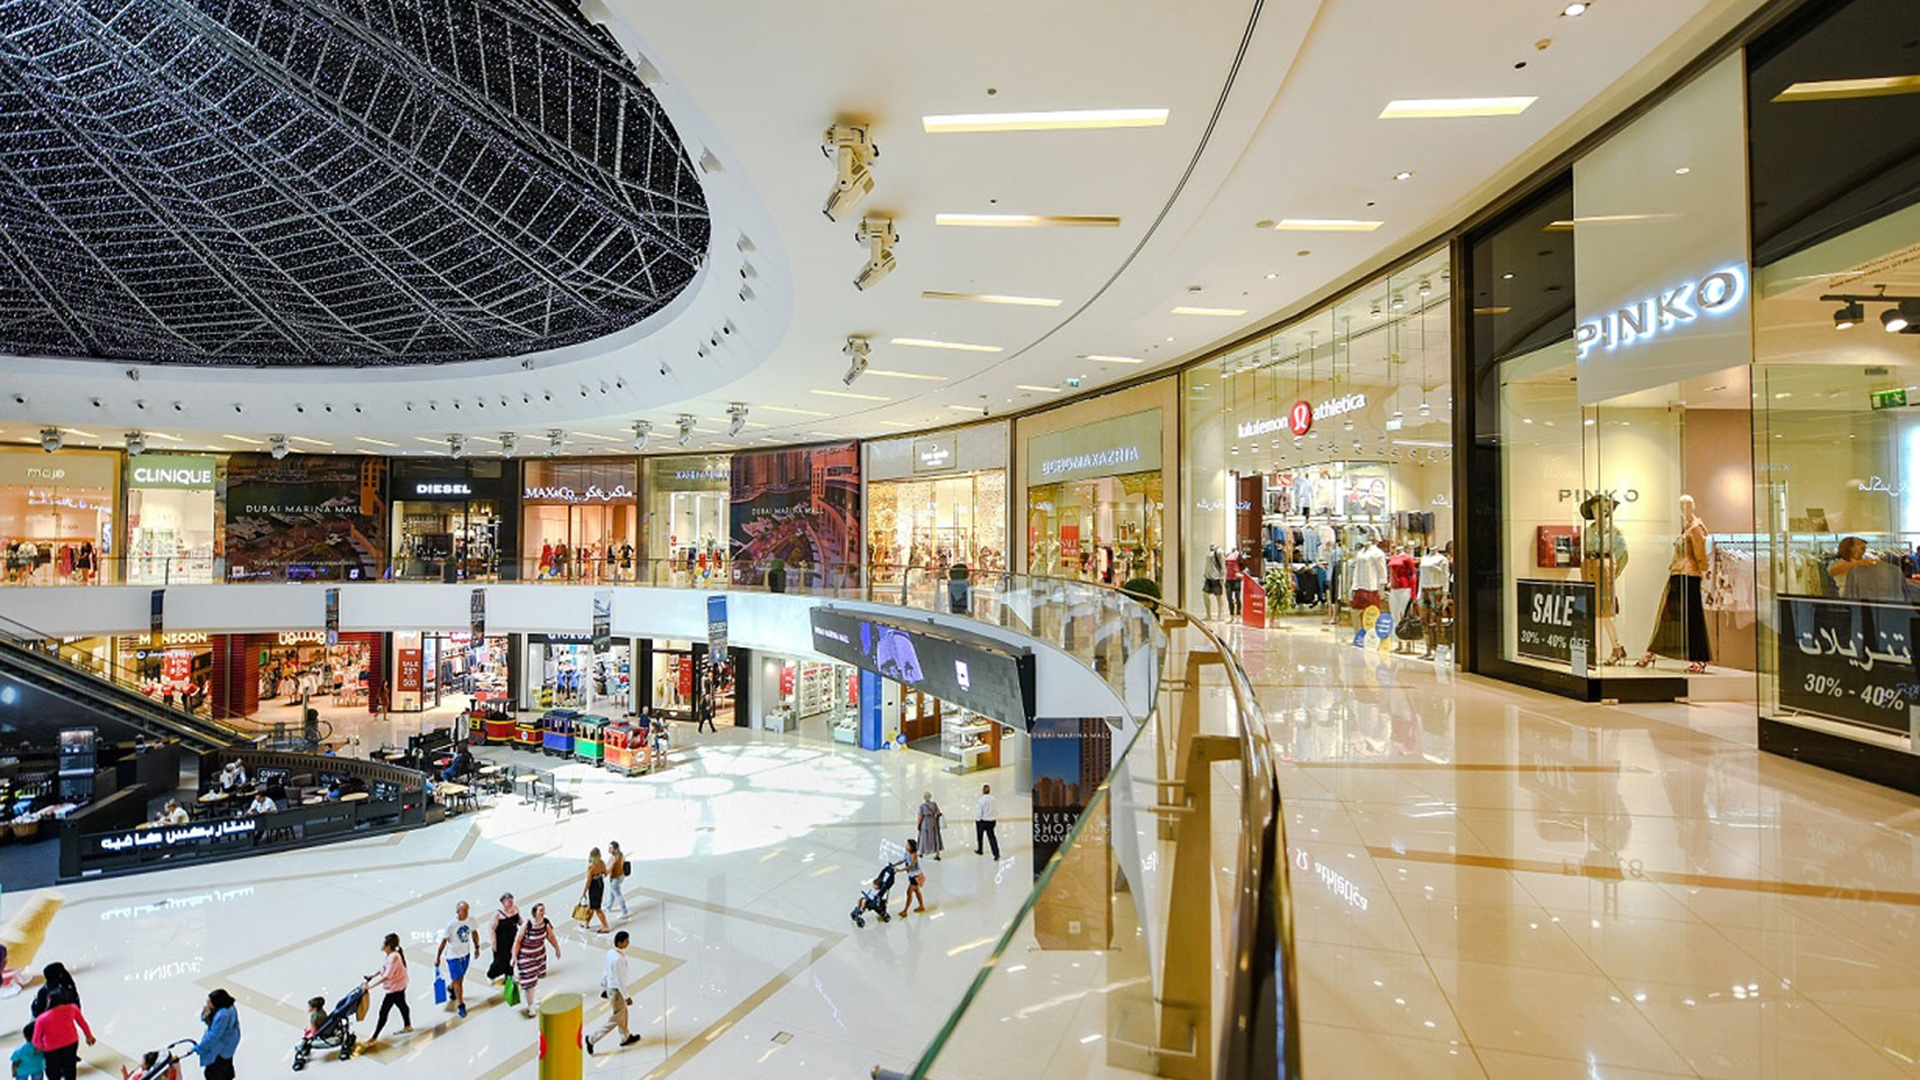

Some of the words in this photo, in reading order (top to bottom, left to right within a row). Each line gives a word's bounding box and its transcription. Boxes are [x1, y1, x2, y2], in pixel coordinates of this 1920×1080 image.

[1577, 270, 1743, 357] PINKO
[1238, 416, 1289, 438] lululemon
[1313, 392, 1367, 421] athletica
[134, 467, 212, 485] CLINIQUE
[416, 483, 472, 495] DIESEL
[1559, 489, 1639, 503] PINKO
[246, 504, 281, 513] DUBAI
[285, 504, 331, 514] MARINA
[334, 504, 365, 514] MALL
[1532, 592, 1576, 627] SALE
[139, 632, 207, 646] MNSOON
[1520, 629, 1540, 644] 30%
[1547, 633, 1567, 649] 40%
[1798, 626, 1913, 671] تنزيلات
[1804, 673, 1843, 698] 30%
[1860, 684, 1905, 711] 40%
[1034, 812, 1080, 823] EVERY
